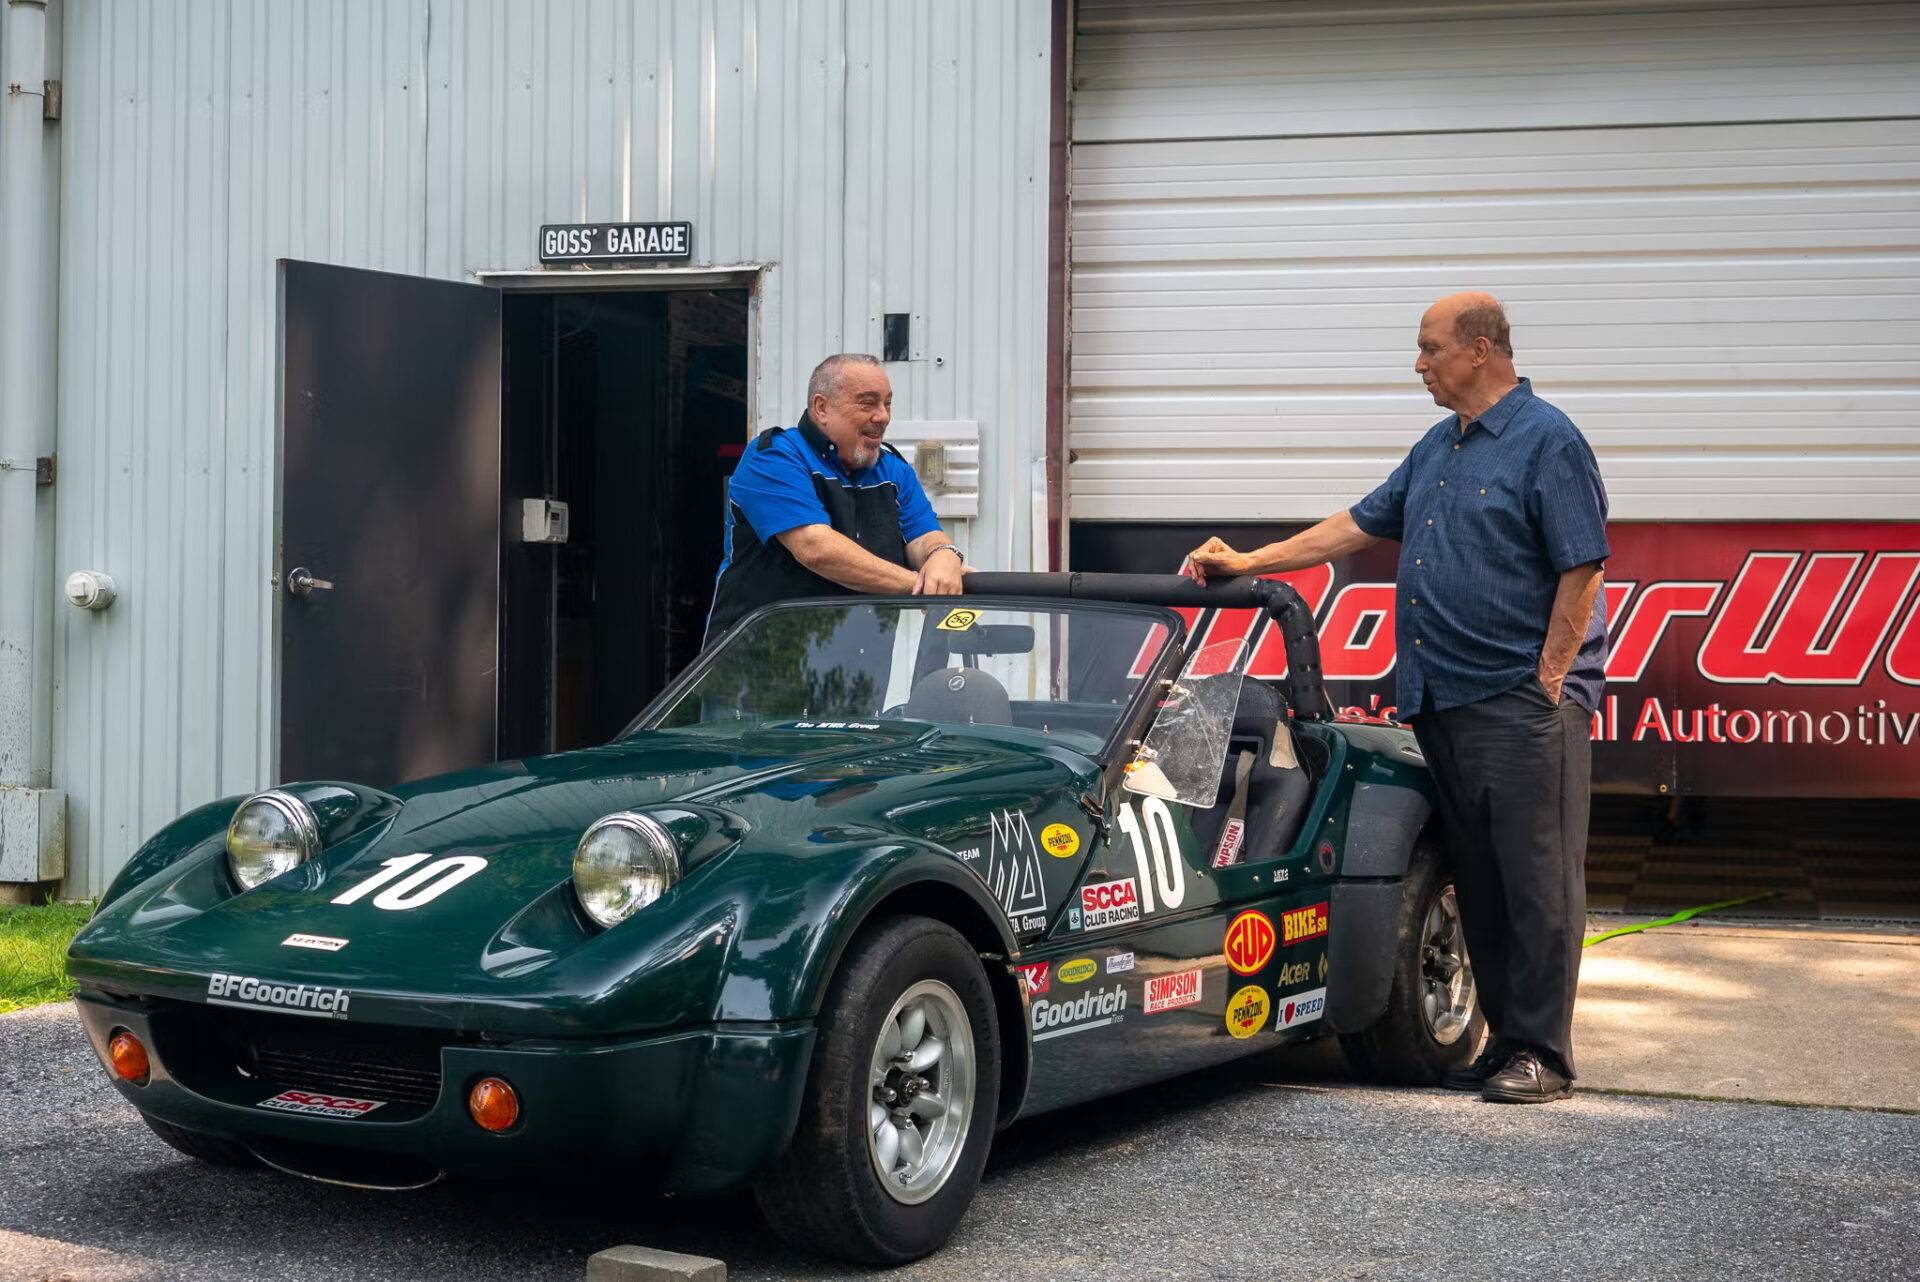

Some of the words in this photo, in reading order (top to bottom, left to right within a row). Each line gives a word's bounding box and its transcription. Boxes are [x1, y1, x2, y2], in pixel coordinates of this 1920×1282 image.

[545, 228, 598, 255] GOSS'
[607, 226, 686, 253] GARAGE
[1631, 697, 1920, 745] Automotiv
[1117, 796, 1185, 914] 10
[1216, 824, 1241, 868] MPSON
[330, 853, 488, 910] 10
[1083, 882, 1137, 911] SCCA
[1022, 915, 1047, 931] Group
[1085, 911, 1107, 928] CLUB
[1108, 905, 1139, 924] RACING
[1284, 908, 1317, 941] BIKE
[208, 973, 350, 1012] BFGoodrich
[1150, 972, 1197, 1002] SIMPSON
[1031, 984, 1127, 1031] Goodrich
[1233, 1000, 1264, 1024] PENNZOIL
[1295, 997, 1323, 1018] SPEED
[263, 1100, 303, 1110] CLUB
[303, 1106, 362, 1117] RACING
[276, 1091, 376, 1111] SCCA
